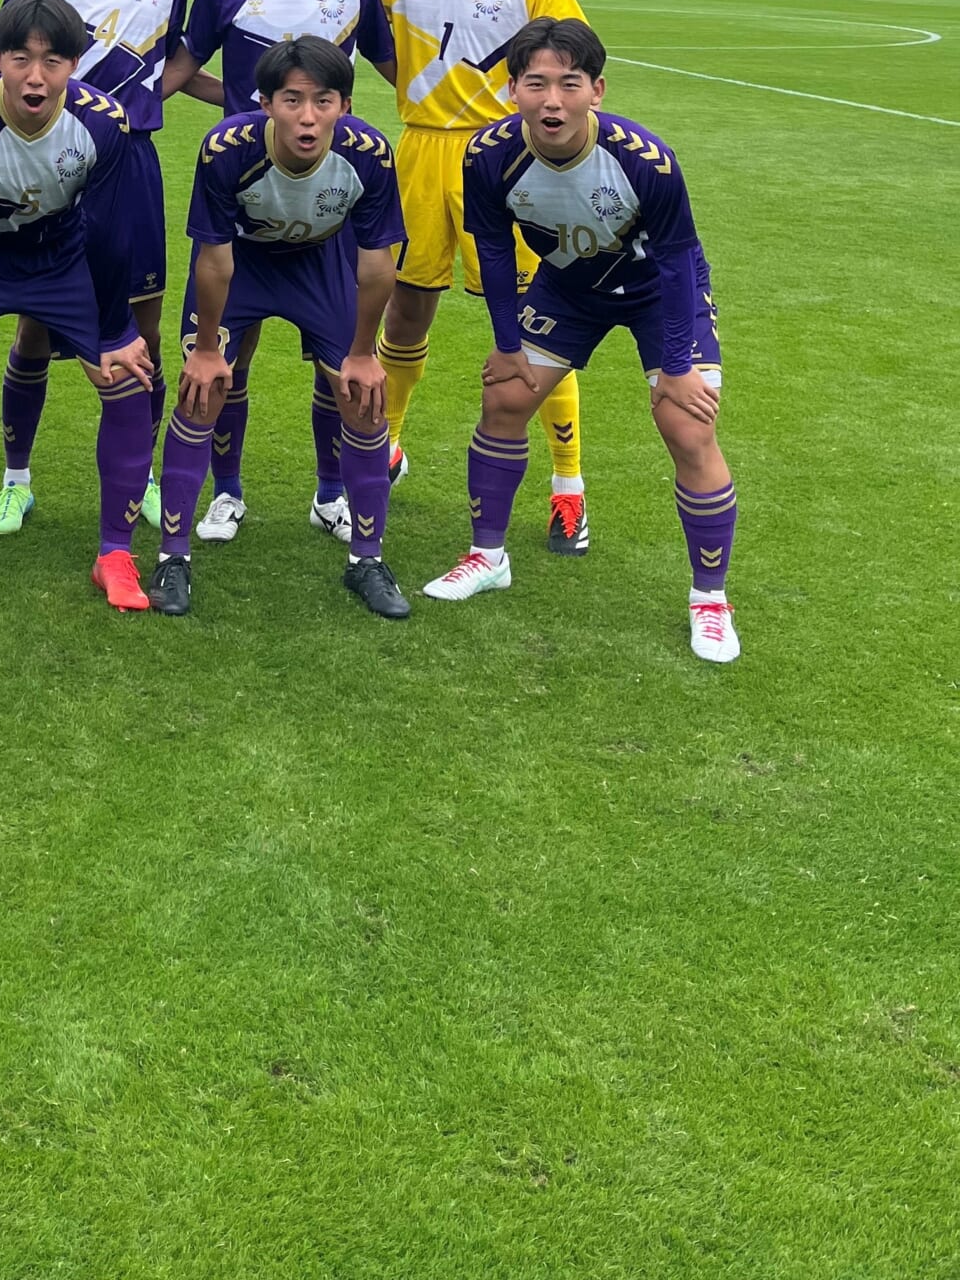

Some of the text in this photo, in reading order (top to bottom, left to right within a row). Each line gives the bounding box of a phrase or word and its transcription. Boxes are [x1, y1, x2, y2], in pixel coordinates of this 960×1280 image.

[94, 8, 121, 48] 4
[438, 21, 455, 61] 1
[555, 222, 598, 258] 10
